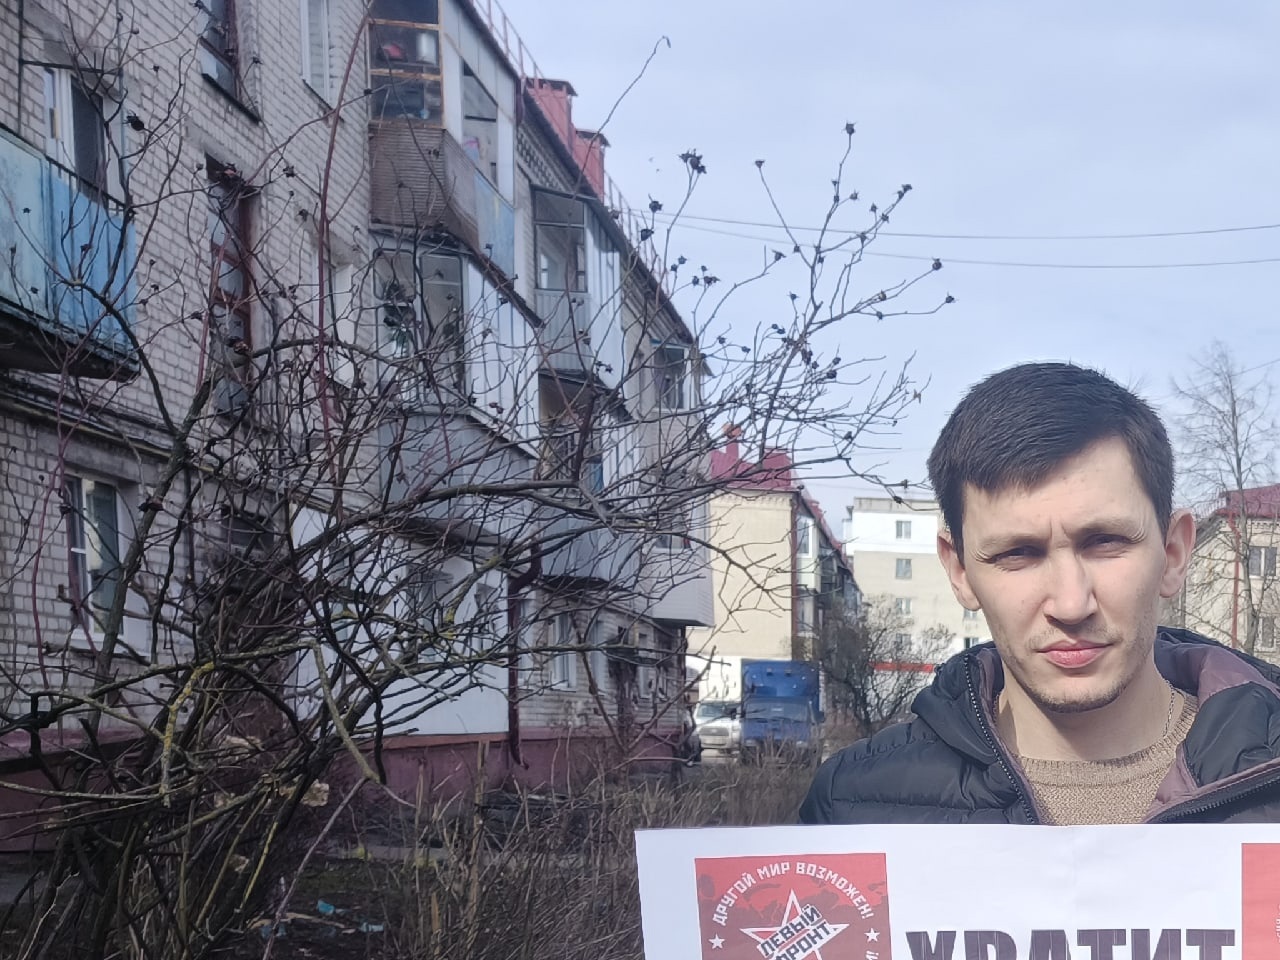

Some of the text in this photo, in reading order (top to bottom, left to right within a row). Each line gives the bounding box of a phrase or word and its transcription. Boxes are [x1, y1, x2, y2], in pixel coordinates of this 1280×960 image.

[713, 861, 874, 926] ДРУГОЙ МИР ВОЗМОЖЕН!
[759, 903, 822, 956] ЛЕВЫЙ
